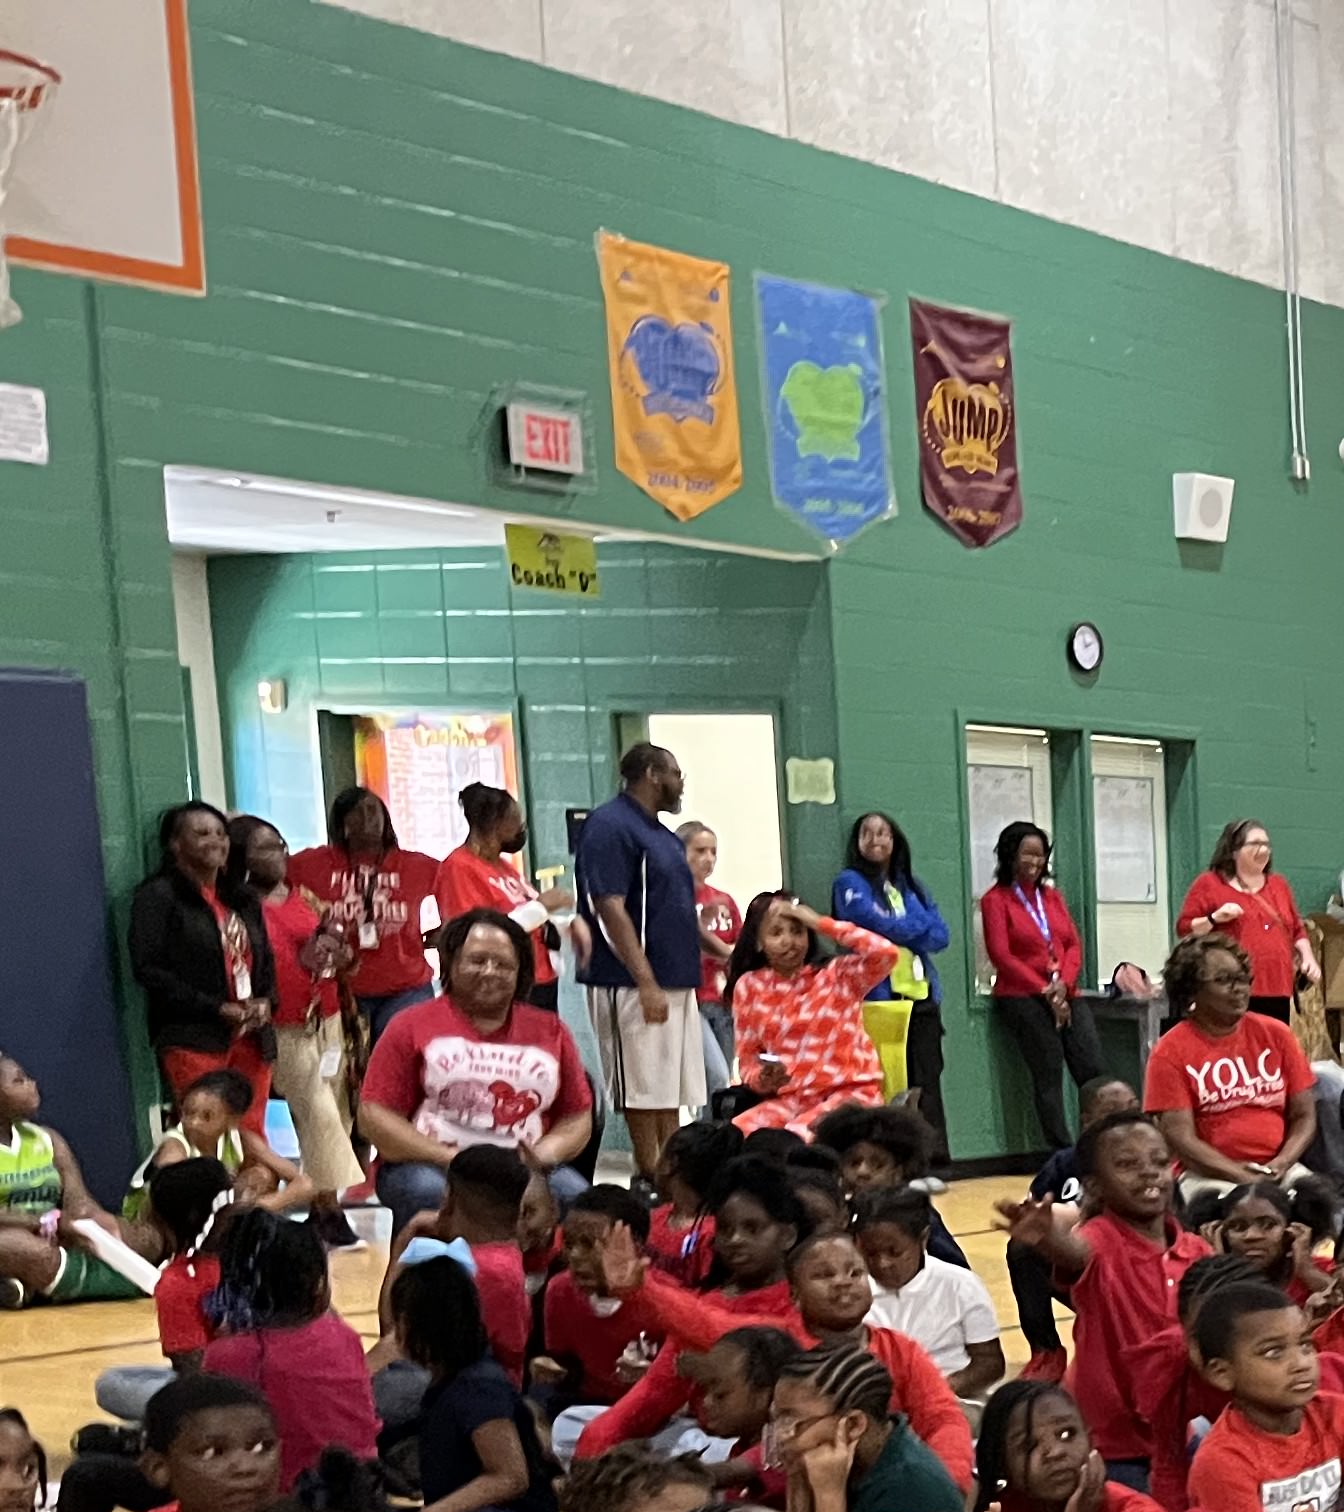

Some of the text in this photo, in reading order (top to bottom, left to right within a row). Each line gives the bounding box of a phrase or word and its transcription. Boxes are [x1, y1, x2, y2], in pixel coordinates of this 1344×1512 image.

[524, 413, 571, 465] EXIT
[938, 387, 999, 451] JUMP
[511, 562, 567, 590] Coach
[1222, 1083, 1256, 1100] Drug
